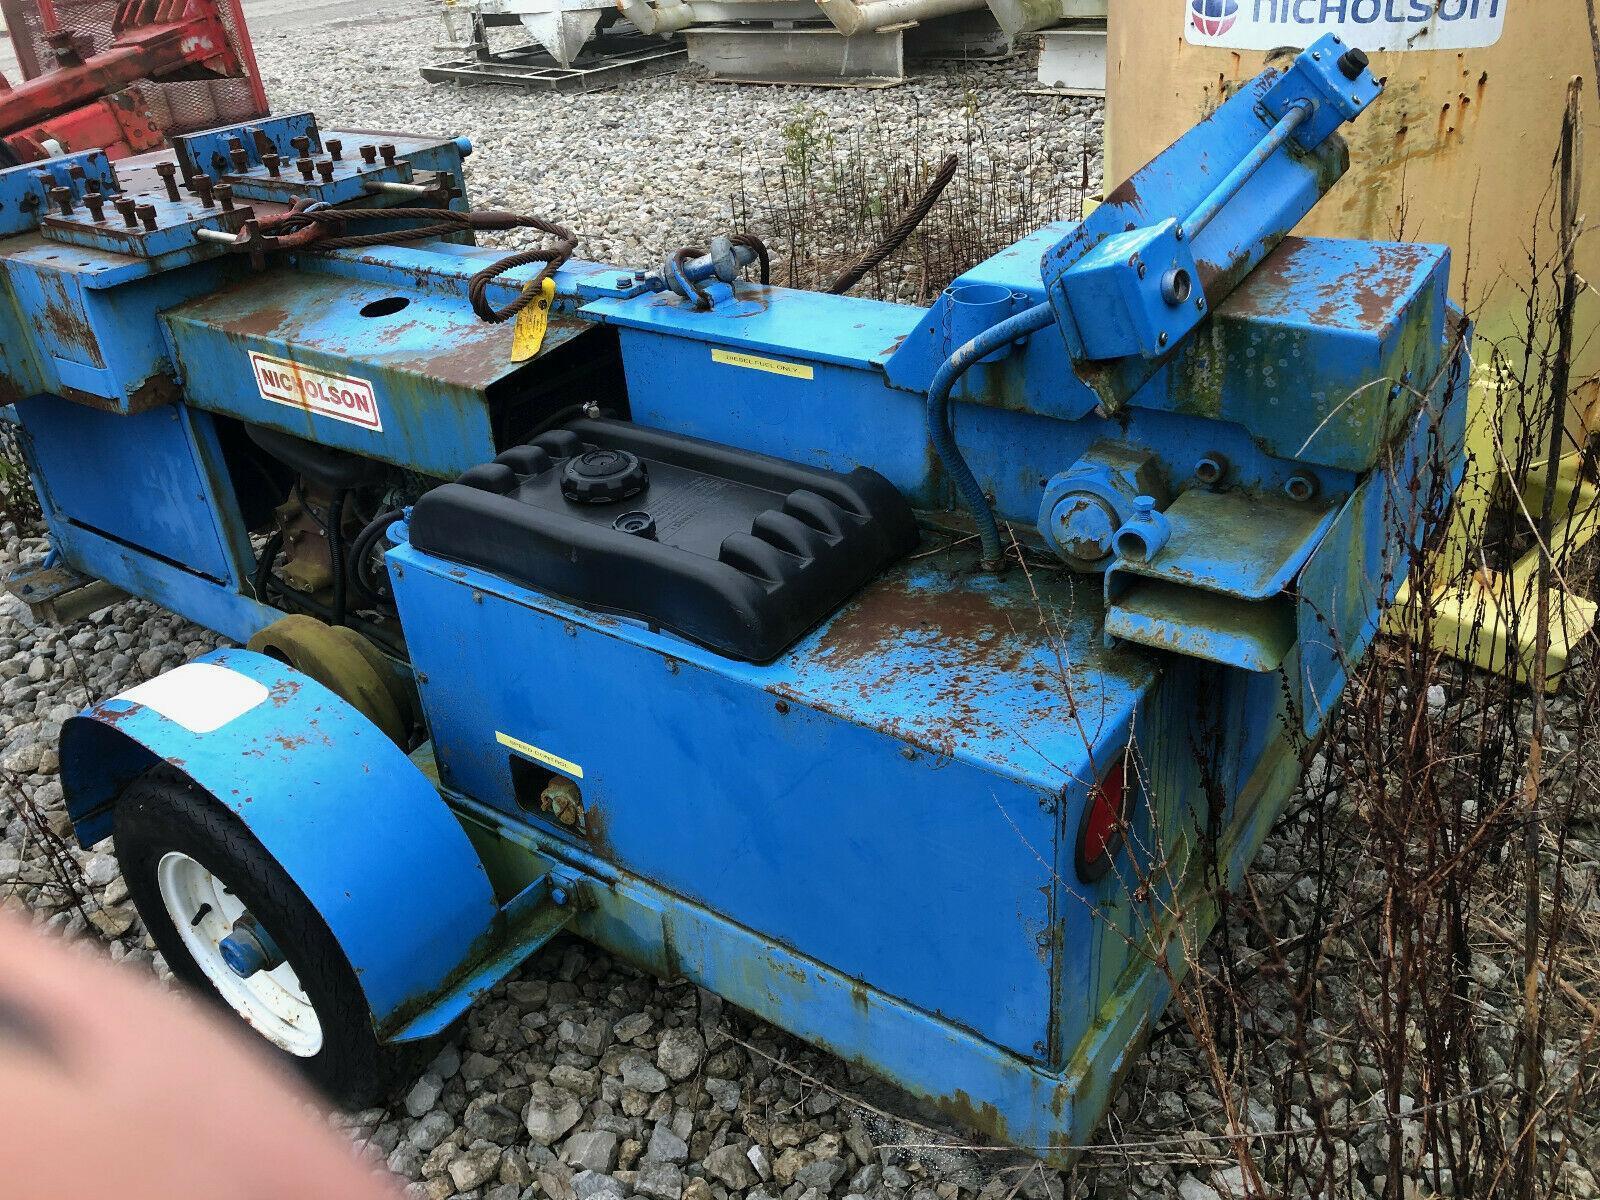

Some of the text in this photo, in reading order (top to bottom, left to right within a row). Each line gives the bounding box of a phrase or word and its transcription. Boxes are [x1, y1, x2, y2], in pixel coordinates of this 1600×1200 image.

[725, 354, 798, 373] DIESEL FUEL ONLY
[509, 739, 569, 769] SPEED CONTROL
